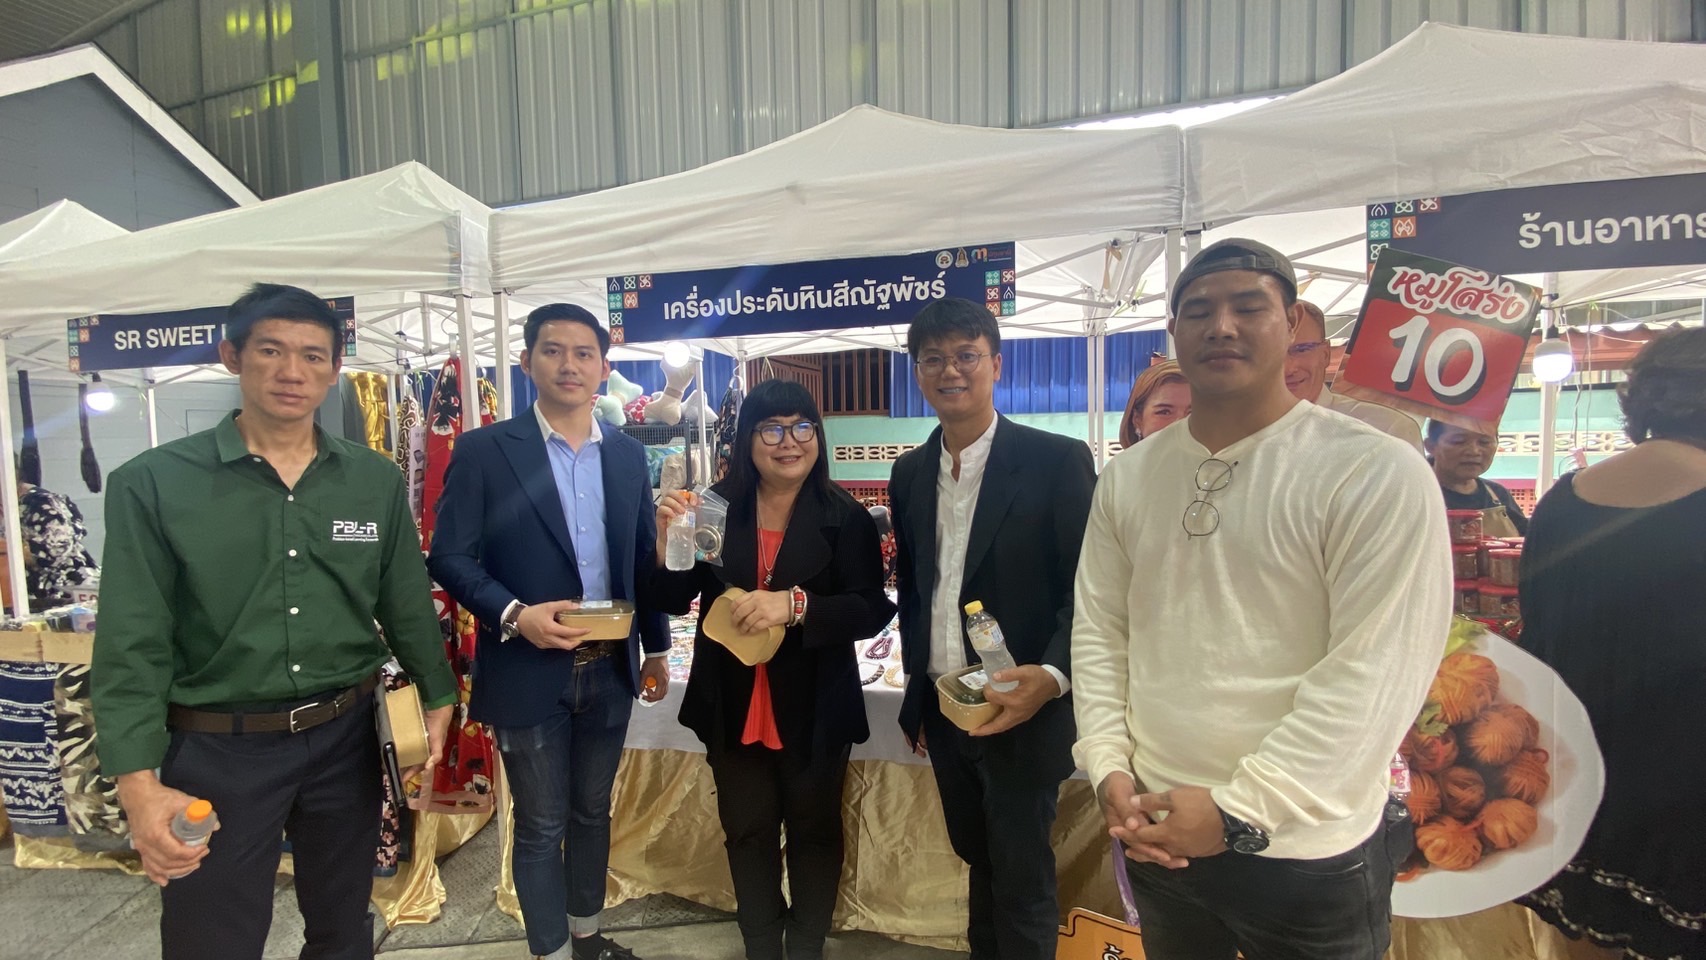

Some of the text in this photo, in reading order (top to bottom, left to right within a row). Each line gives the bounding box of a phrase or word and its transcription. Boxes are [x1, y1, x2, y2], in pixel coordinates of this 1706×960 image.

[663, 270, 946, 320] เครื่องประดับหินสีณัฐพัชร์
[1388, 266, 1529, 324] หมูโสร่ง
[114, 330, 141, 350] SR
[146, 325, 216, 348] SWEET
[1389, 315, 1485, 398] 10
